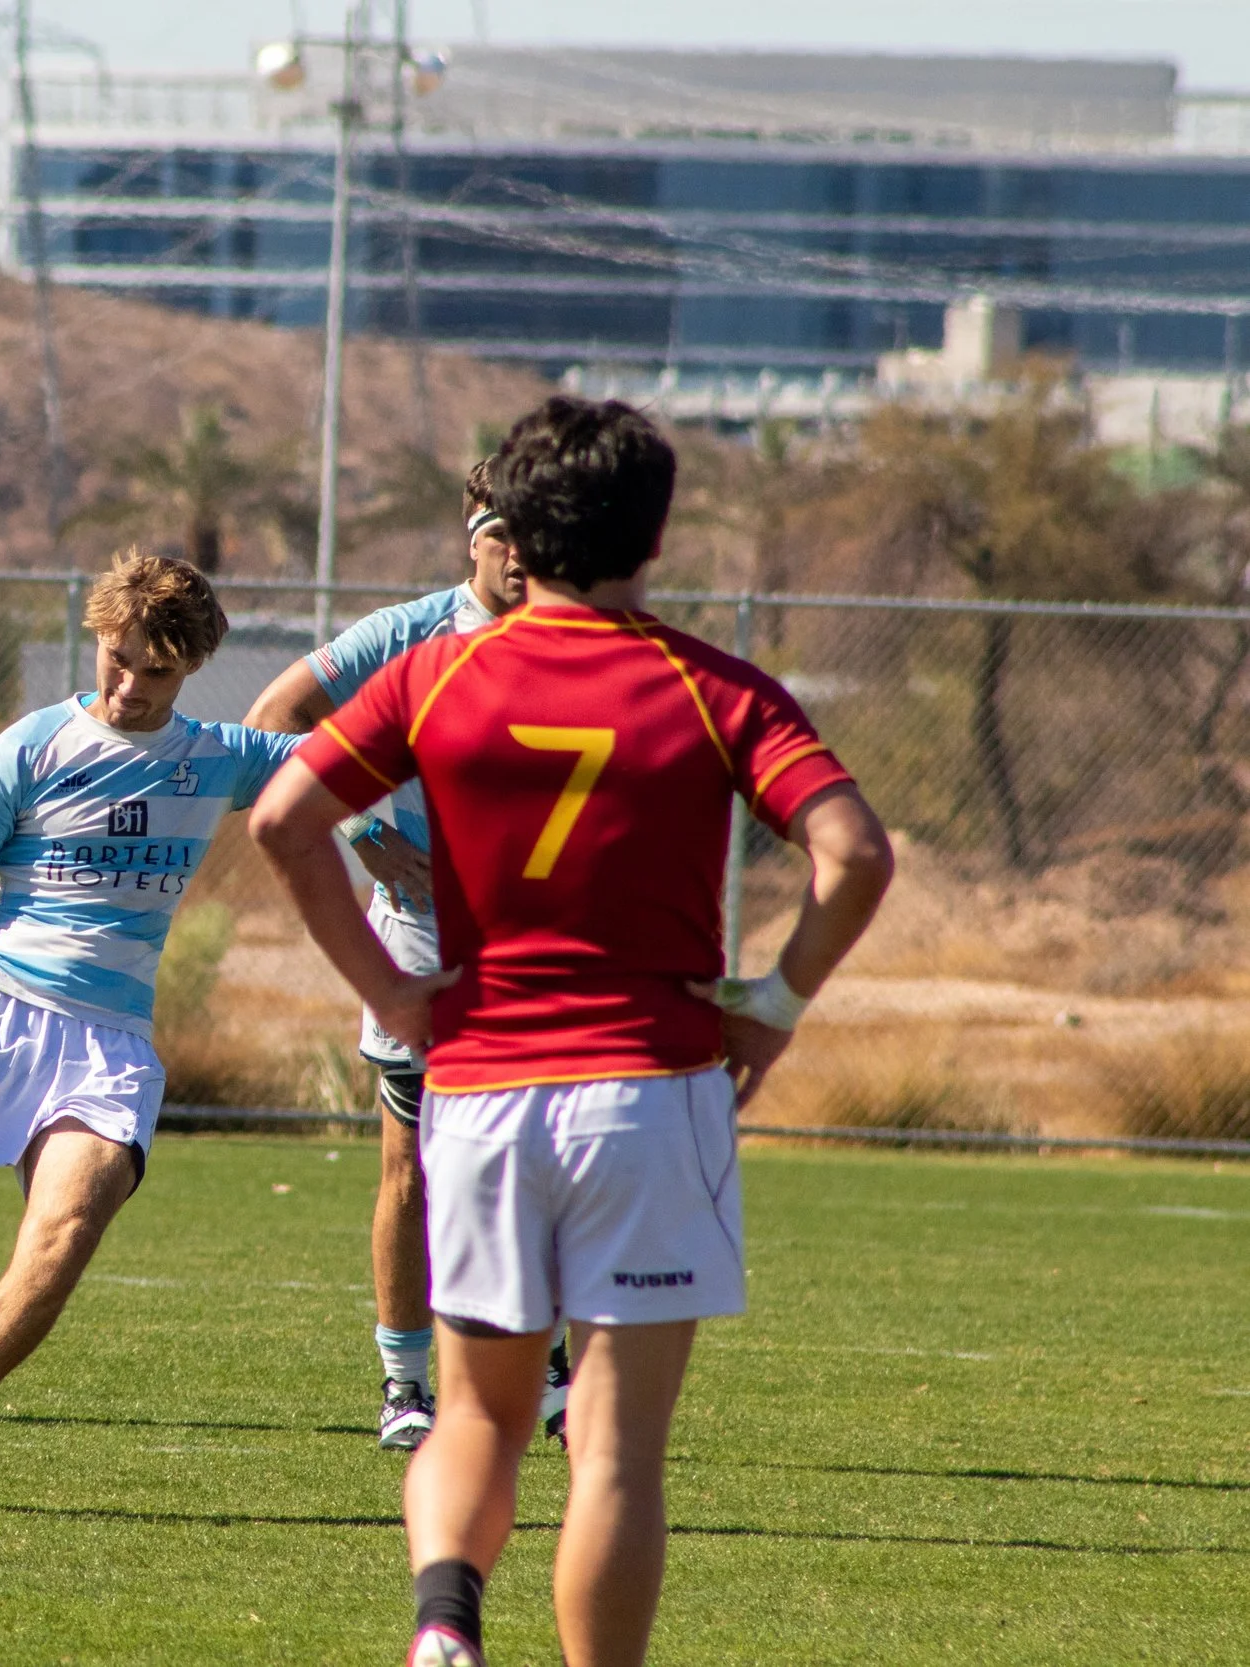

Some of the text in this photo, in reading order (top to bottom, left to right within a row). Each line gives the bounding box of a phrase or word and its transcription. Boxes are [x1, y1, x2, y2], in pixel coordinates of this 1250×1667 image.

[508, 724, 616, 880] 7
[114, 803, 143, 833] BH
[50, 841, 191, 868] BARTELL
[47, 862, 185, 895] HOTELS
